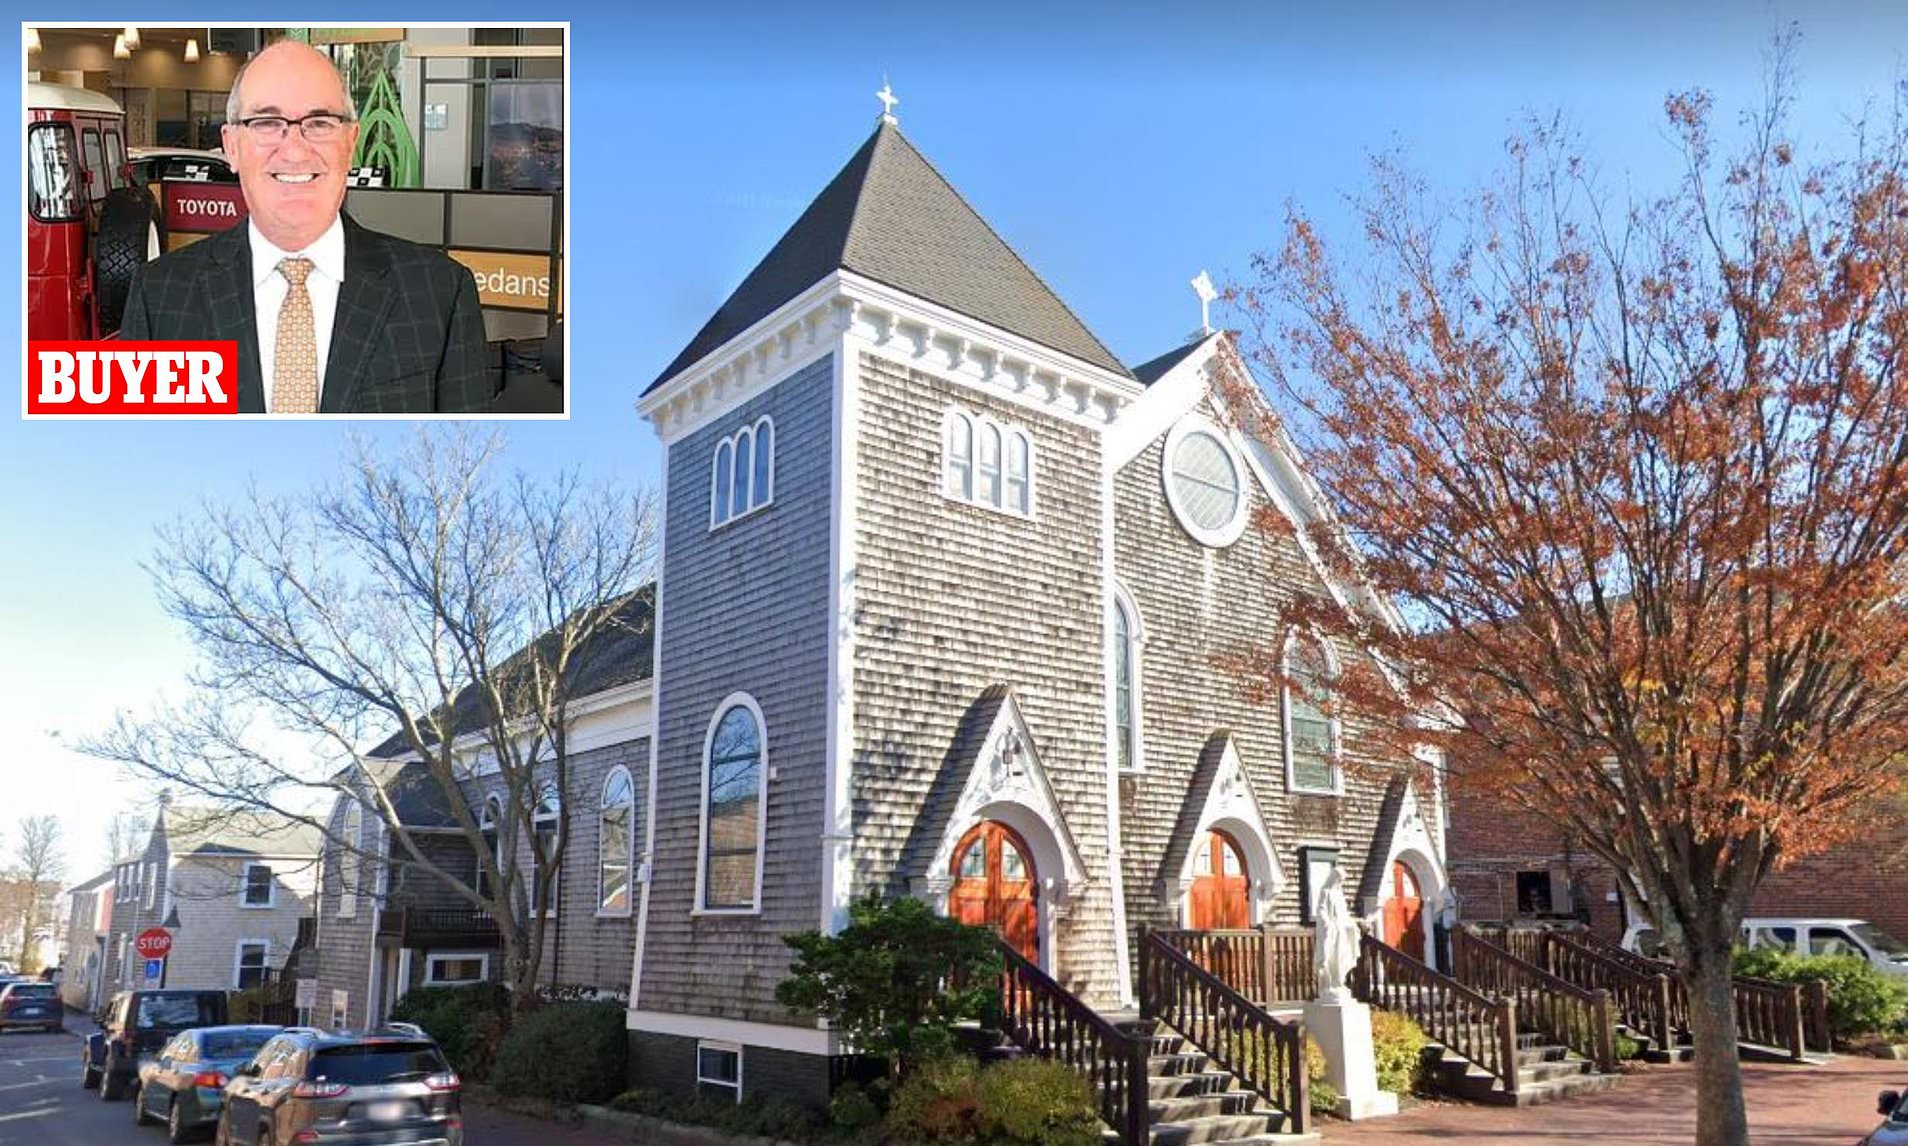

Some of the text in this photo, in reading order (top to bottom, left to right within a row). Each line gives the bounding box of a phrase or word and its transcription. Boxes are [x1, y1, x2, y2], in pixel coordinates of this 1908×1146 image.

[177, 199, 237, 217] TOYOTA
[474, 267, 550, 297] edans
[139, 936, 170, 949] STOP
